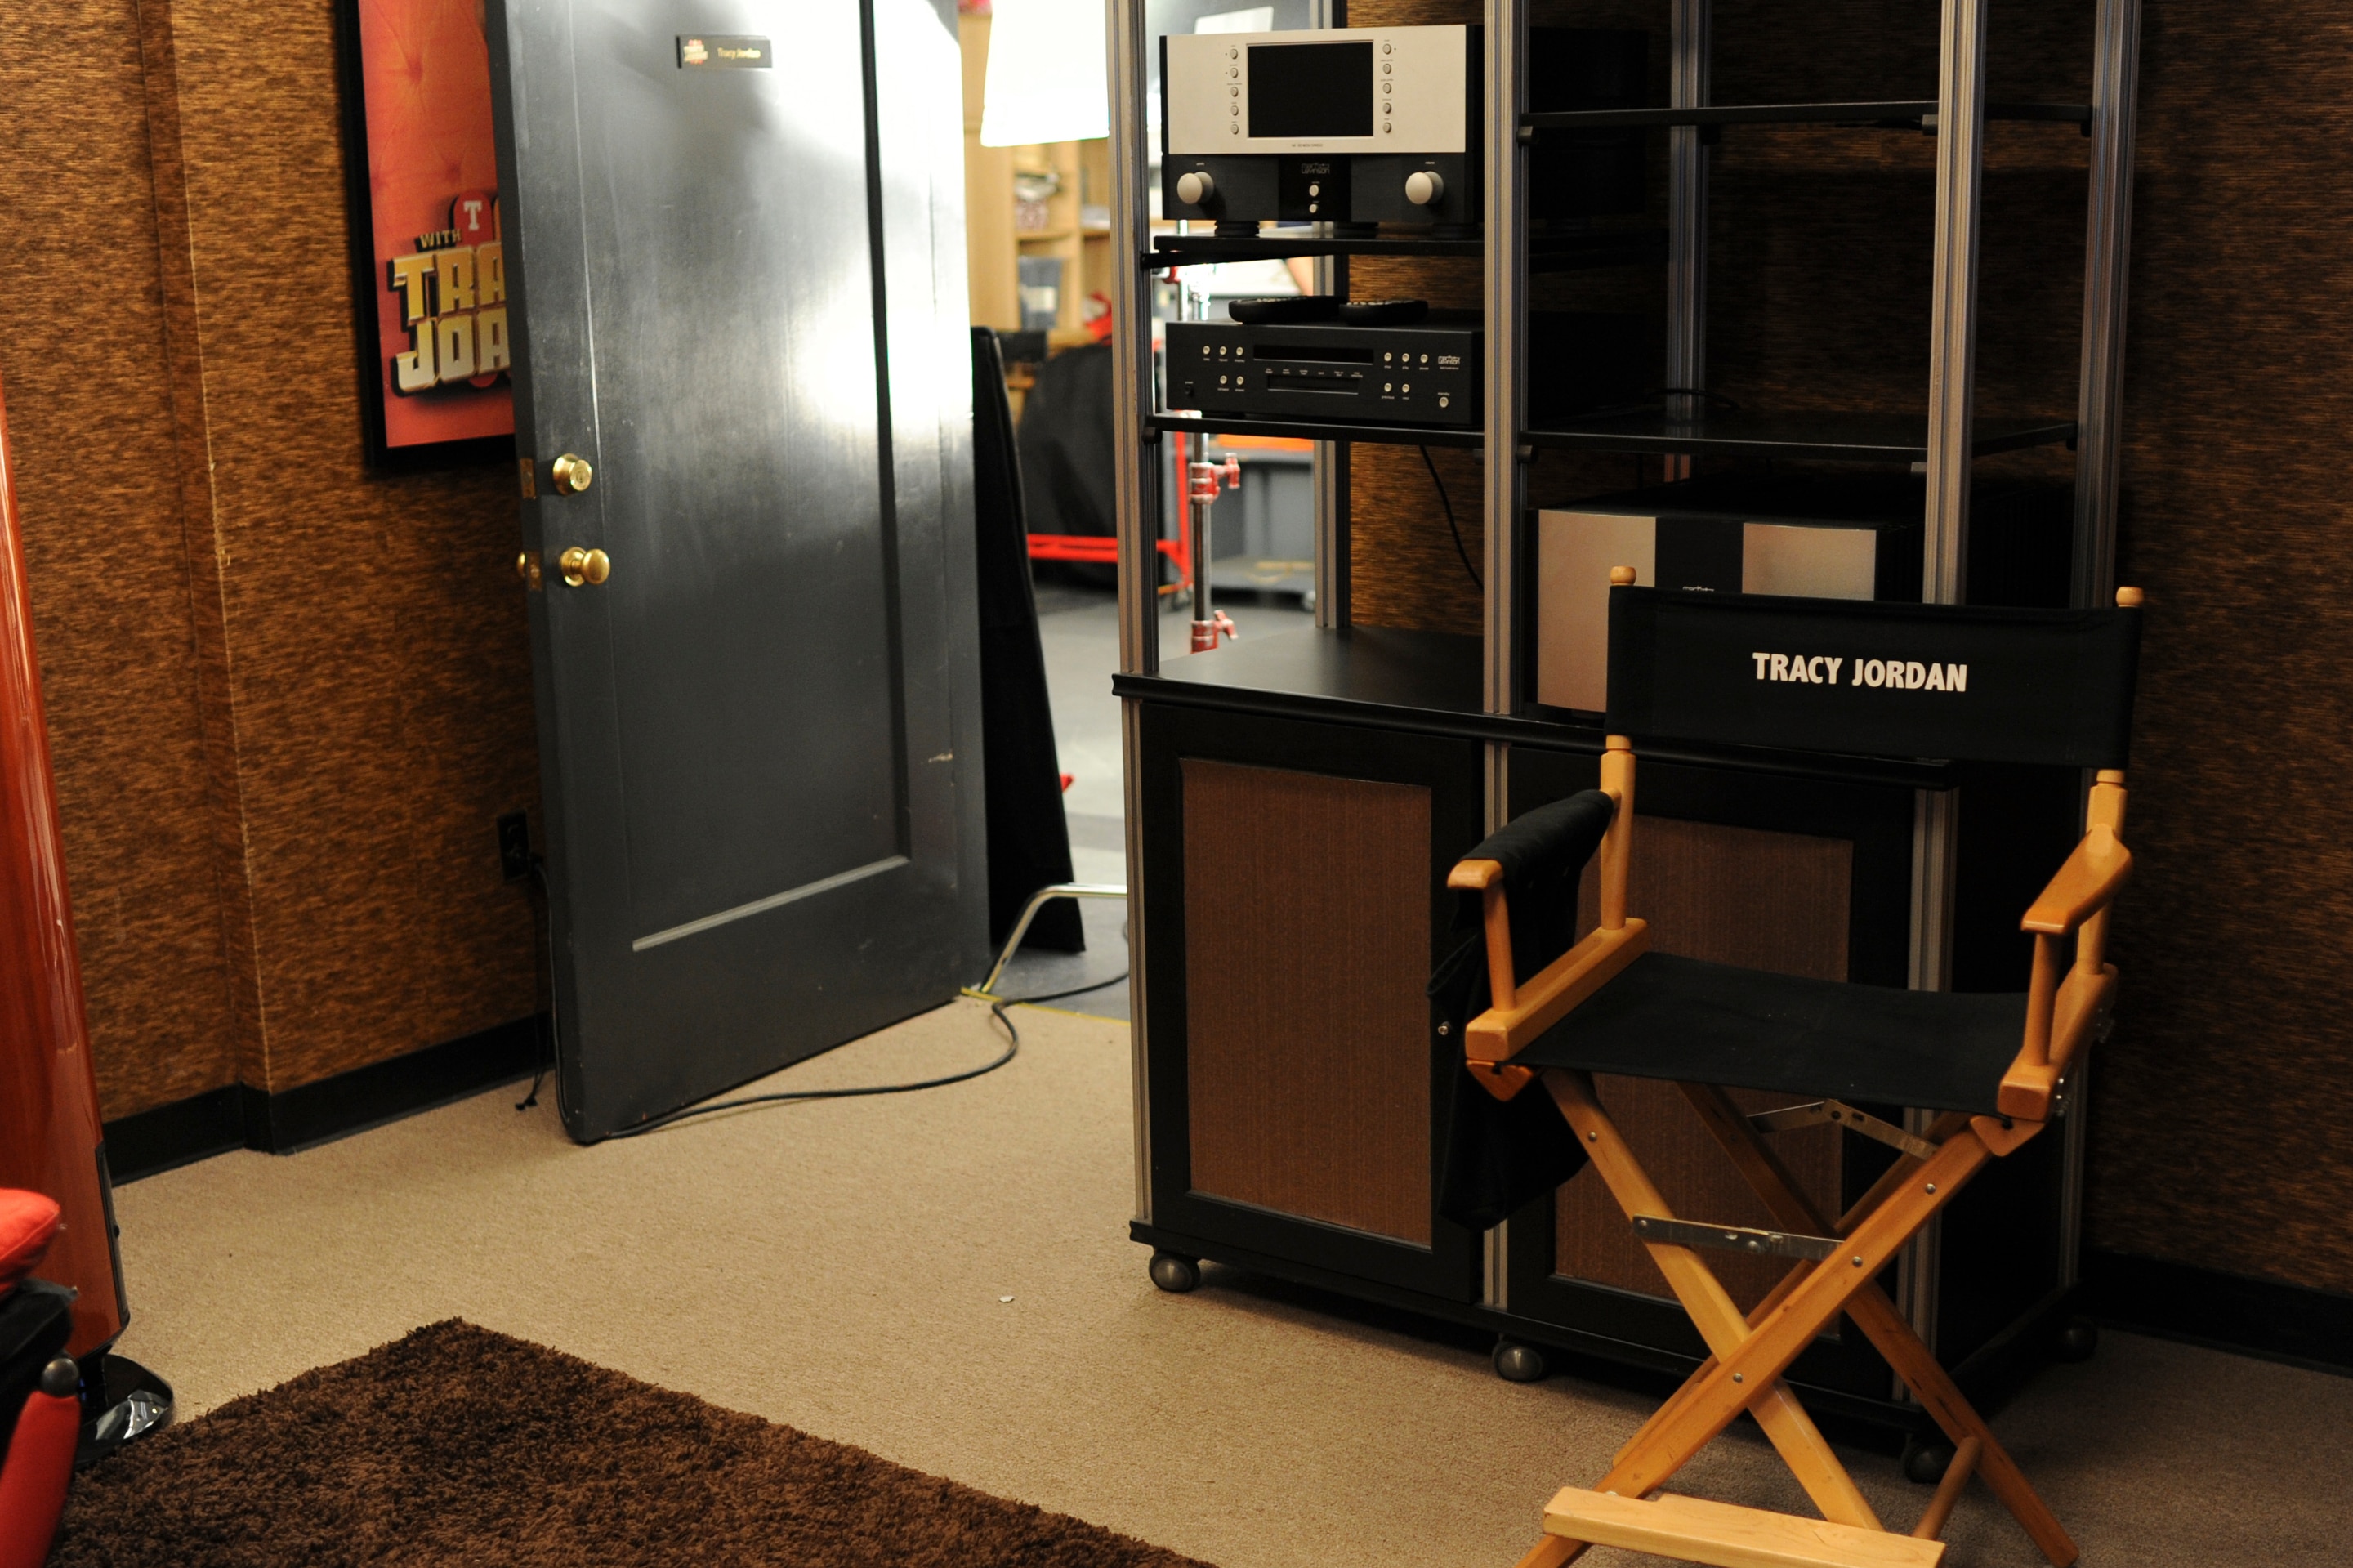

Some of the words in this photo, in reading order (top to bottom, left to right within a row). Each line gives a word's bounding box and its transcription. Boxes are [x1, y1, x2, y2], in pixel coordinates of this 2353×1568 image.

[420, 229, 462, 248] WITH
[1752, 652, 1843, 684] TRACY
[1852, 659, 1967, 692] JORDAN
